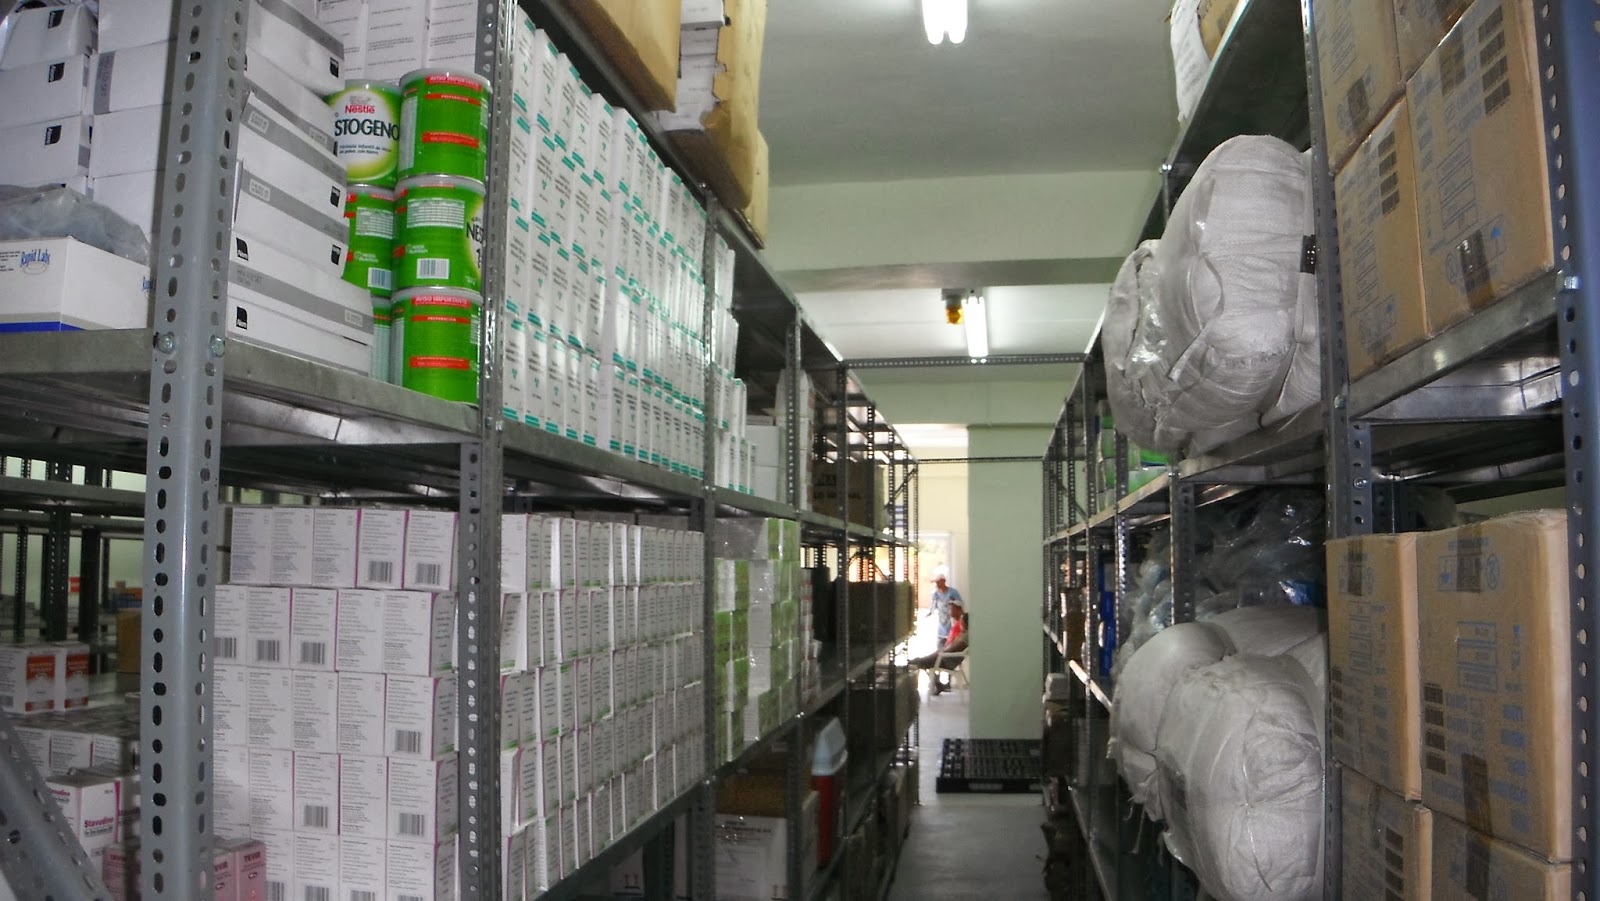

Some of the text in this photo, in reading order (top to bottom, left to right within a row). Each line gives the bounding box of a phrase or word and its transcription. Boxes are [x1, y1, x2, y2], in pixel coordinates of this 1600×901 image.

[334, 118, 400, 141] STOGENO
[20, 249, 37, 268] Rapid
[37, 249, 51, 265] Labs
[84, 816, 114, 828] Stavudine
